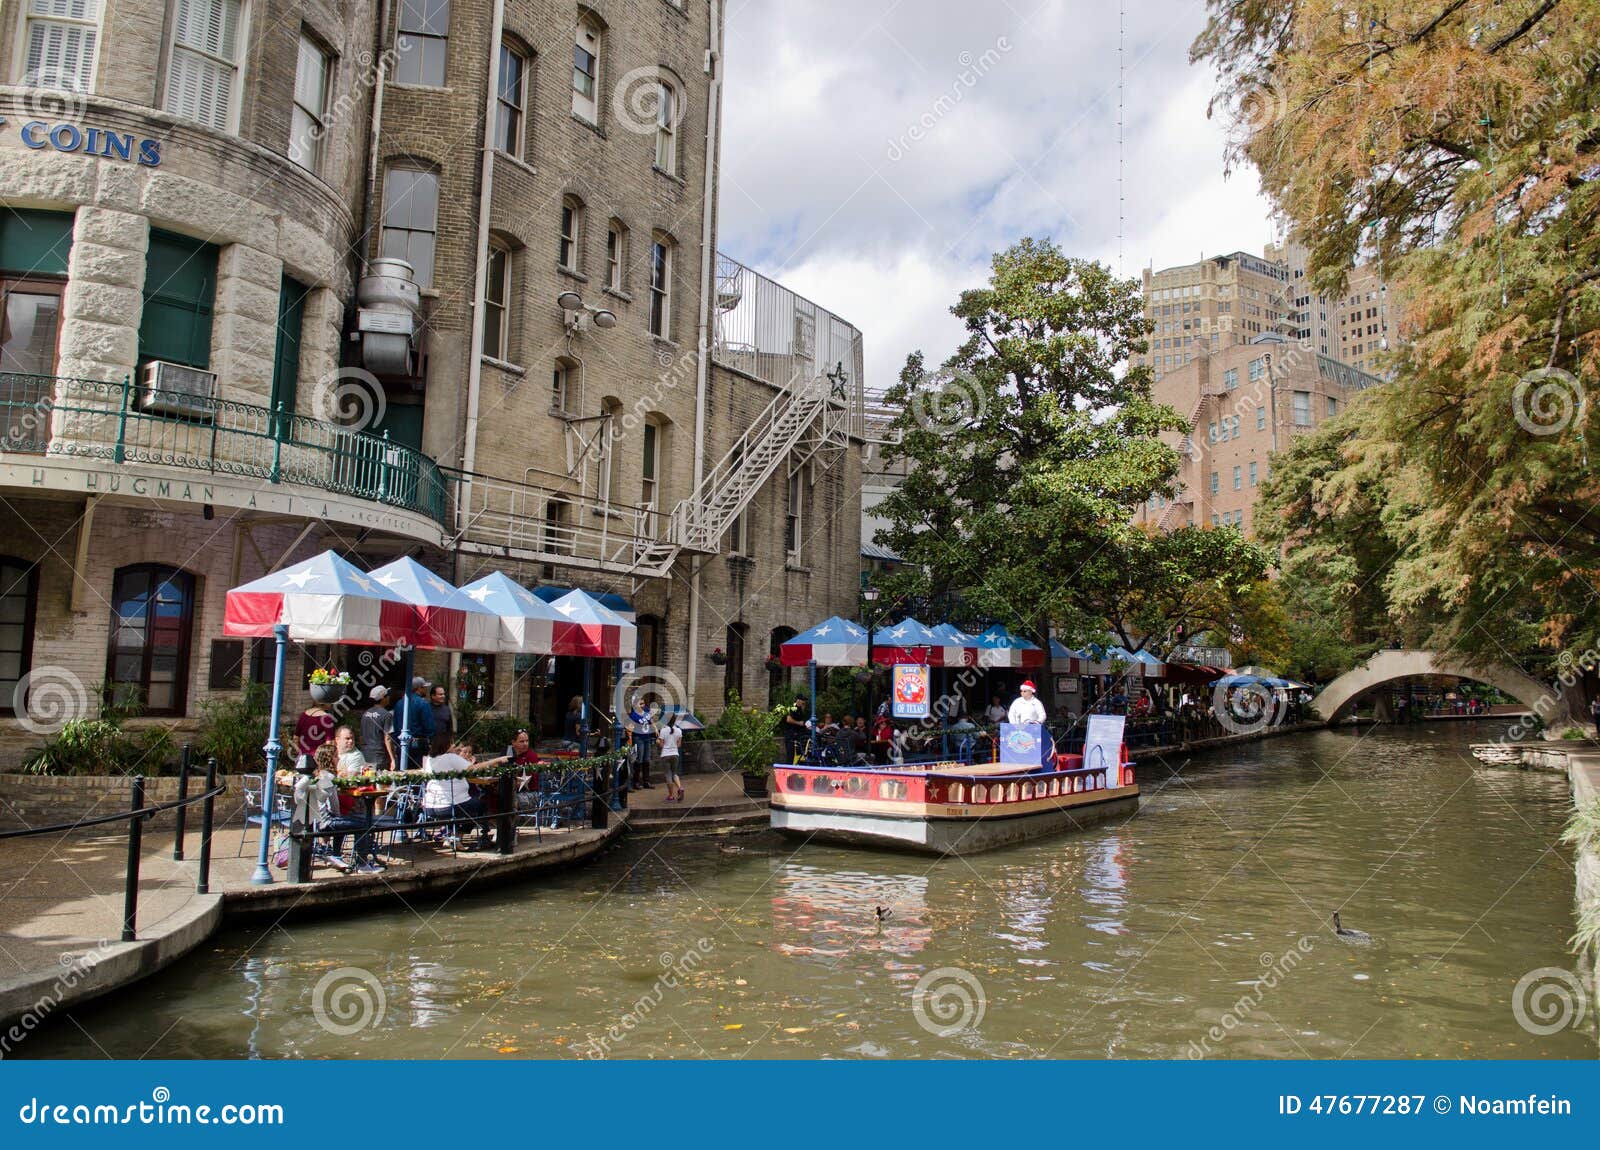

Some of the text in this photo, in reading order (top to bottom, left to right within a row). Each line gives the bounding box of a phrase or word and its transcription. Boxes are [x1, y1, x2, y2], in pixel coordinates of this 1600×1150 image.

[21, 120, 161, 167] COINS
[86, 473, 214, 500] HUGMAN
[897, 703, 924, 713] OF TEXAS
